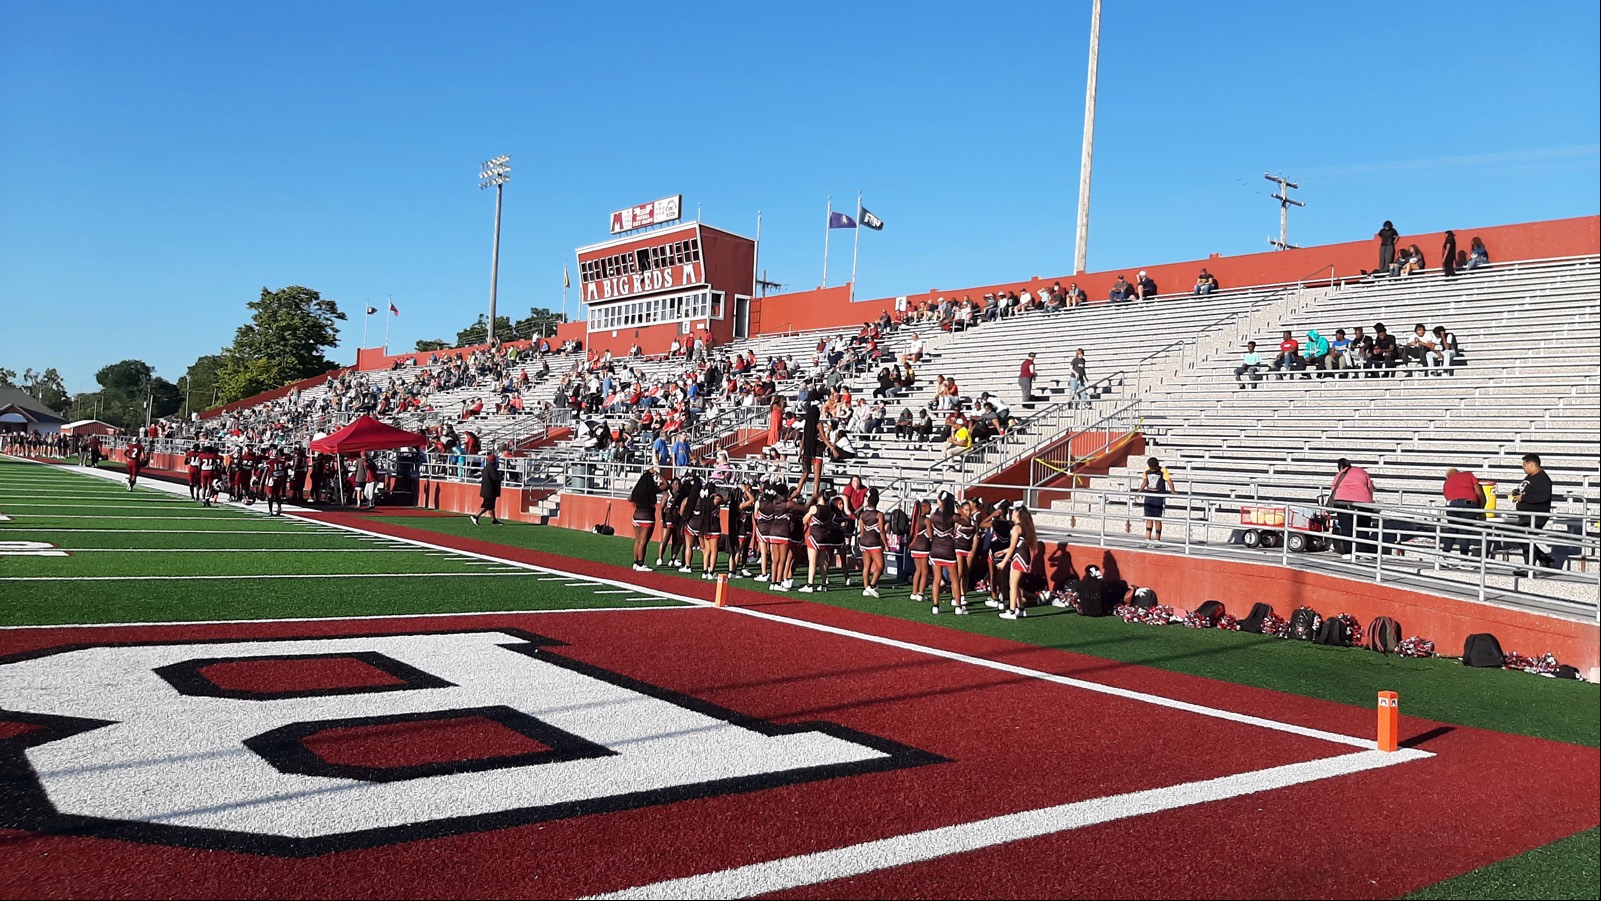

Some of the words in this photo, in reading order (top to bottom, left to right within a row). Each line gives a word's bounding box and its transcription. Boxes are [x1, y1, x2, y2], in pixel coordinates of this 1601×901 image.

[587, 283, 598, 301] M
[603, 276, 630, 298] BIG
[633, 269, 673, 293] REDS
[682, 264, 696, 286] M
[132, 448, 138, 458] 2
